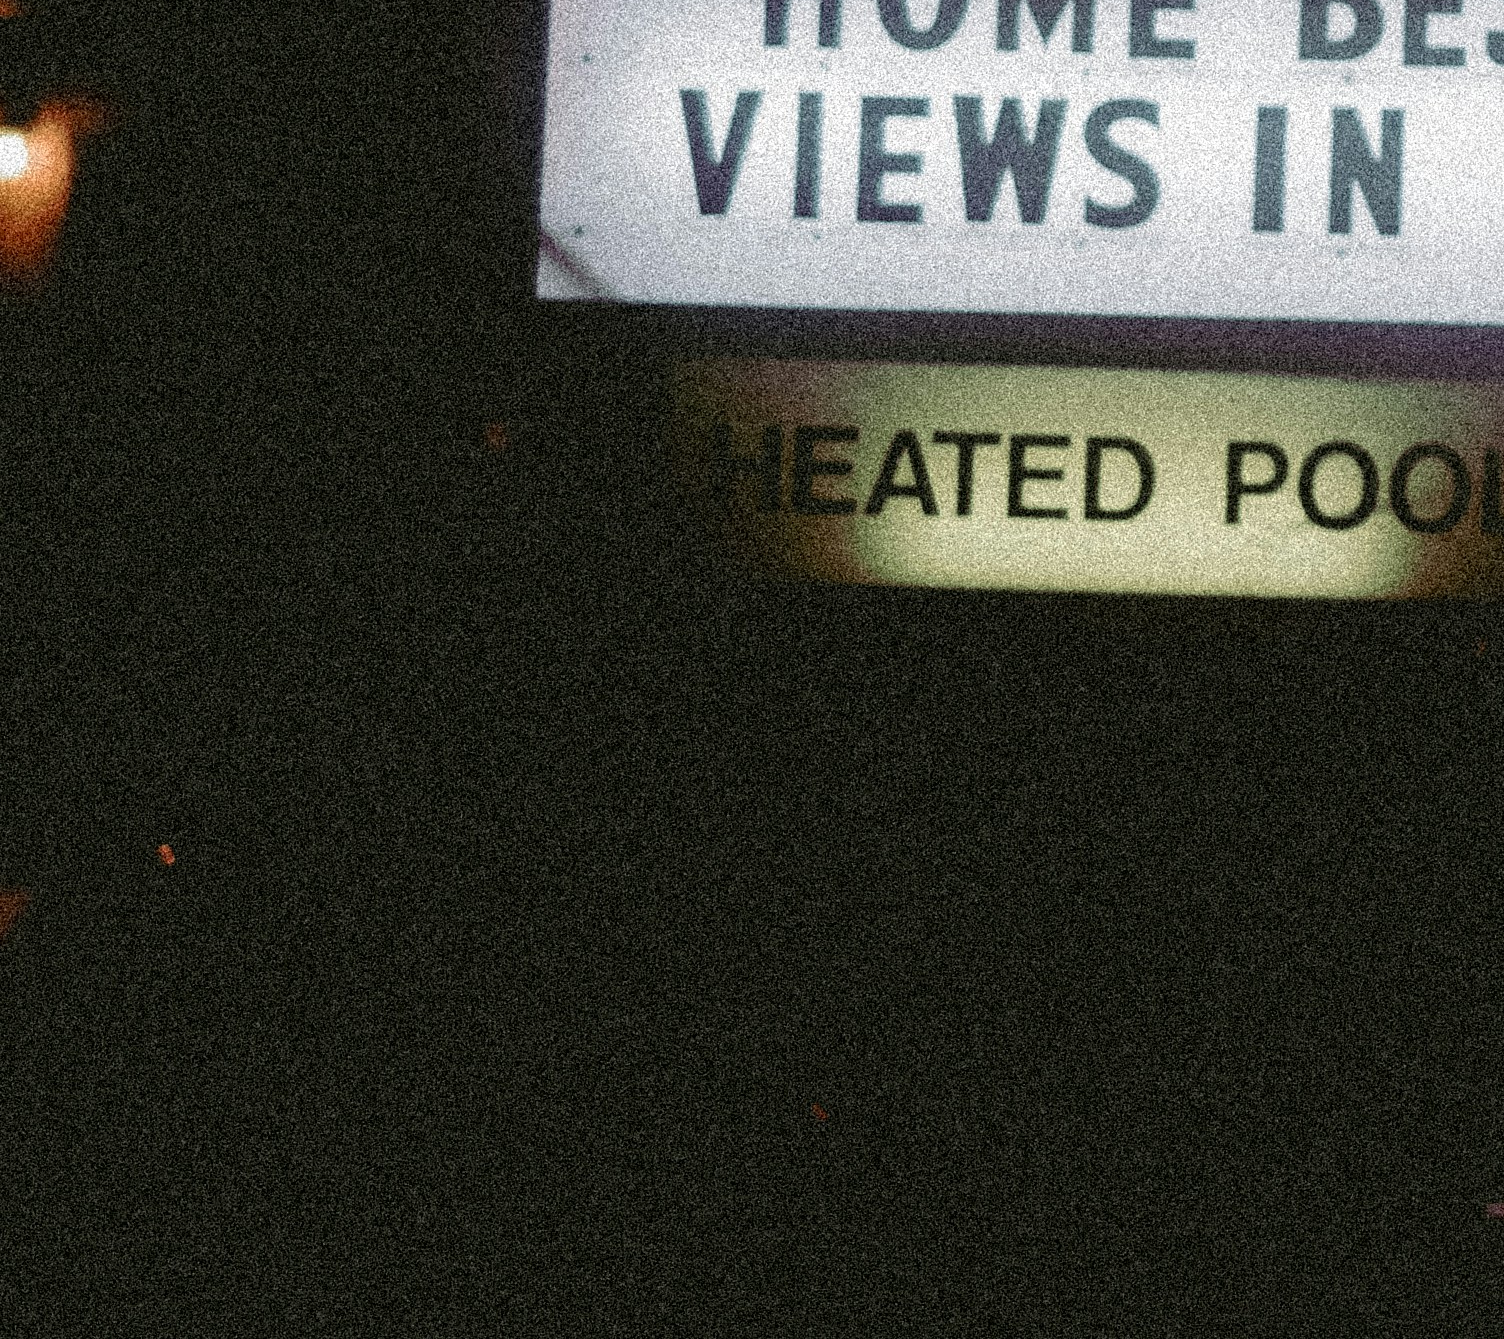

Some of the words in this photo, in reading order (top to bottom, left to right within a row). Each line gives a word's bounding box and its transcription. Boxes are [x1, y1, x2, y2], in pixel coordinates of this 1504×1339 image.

[678, 87, 1162, 232] VIEWS
[1250, 105, 1406, 238] IN
[714, 419, 1158, 525] HEATED
